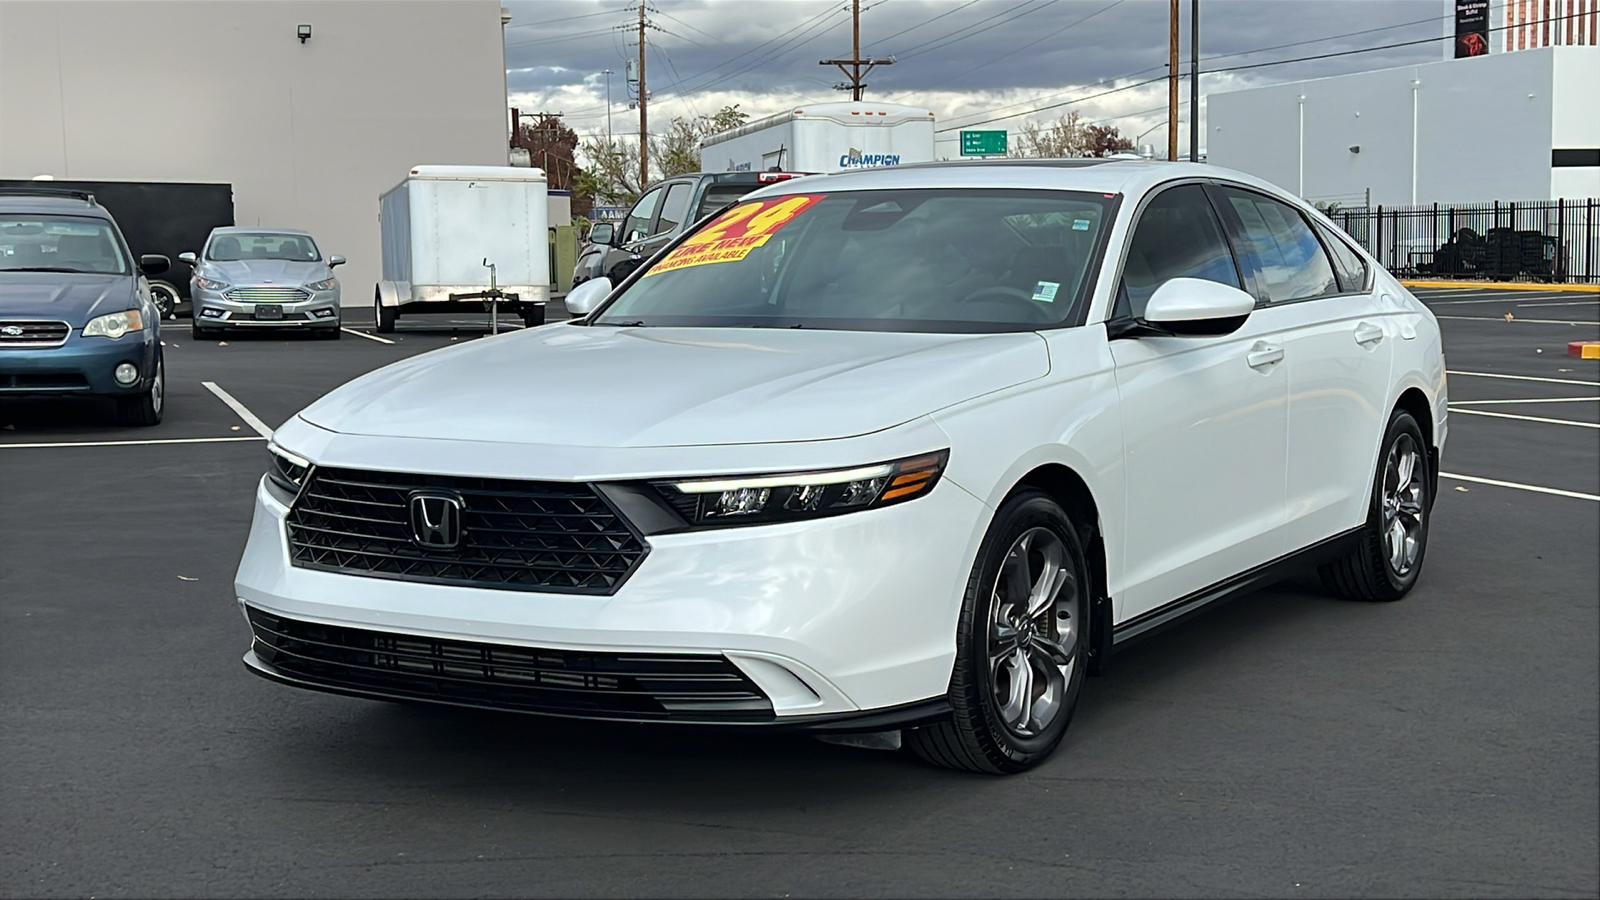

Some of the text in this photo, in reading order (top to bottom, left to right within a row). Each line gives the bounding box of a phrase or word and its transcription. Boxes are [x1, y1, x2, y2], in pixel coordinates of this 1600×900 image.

[840, 154, 900, 167] CHAMPION
[683, 197, 811, 246] 24
[668, 235, 764, 260] LIKE NEW
[648, 249, 748, 274] FINANCING AVAILABLE
